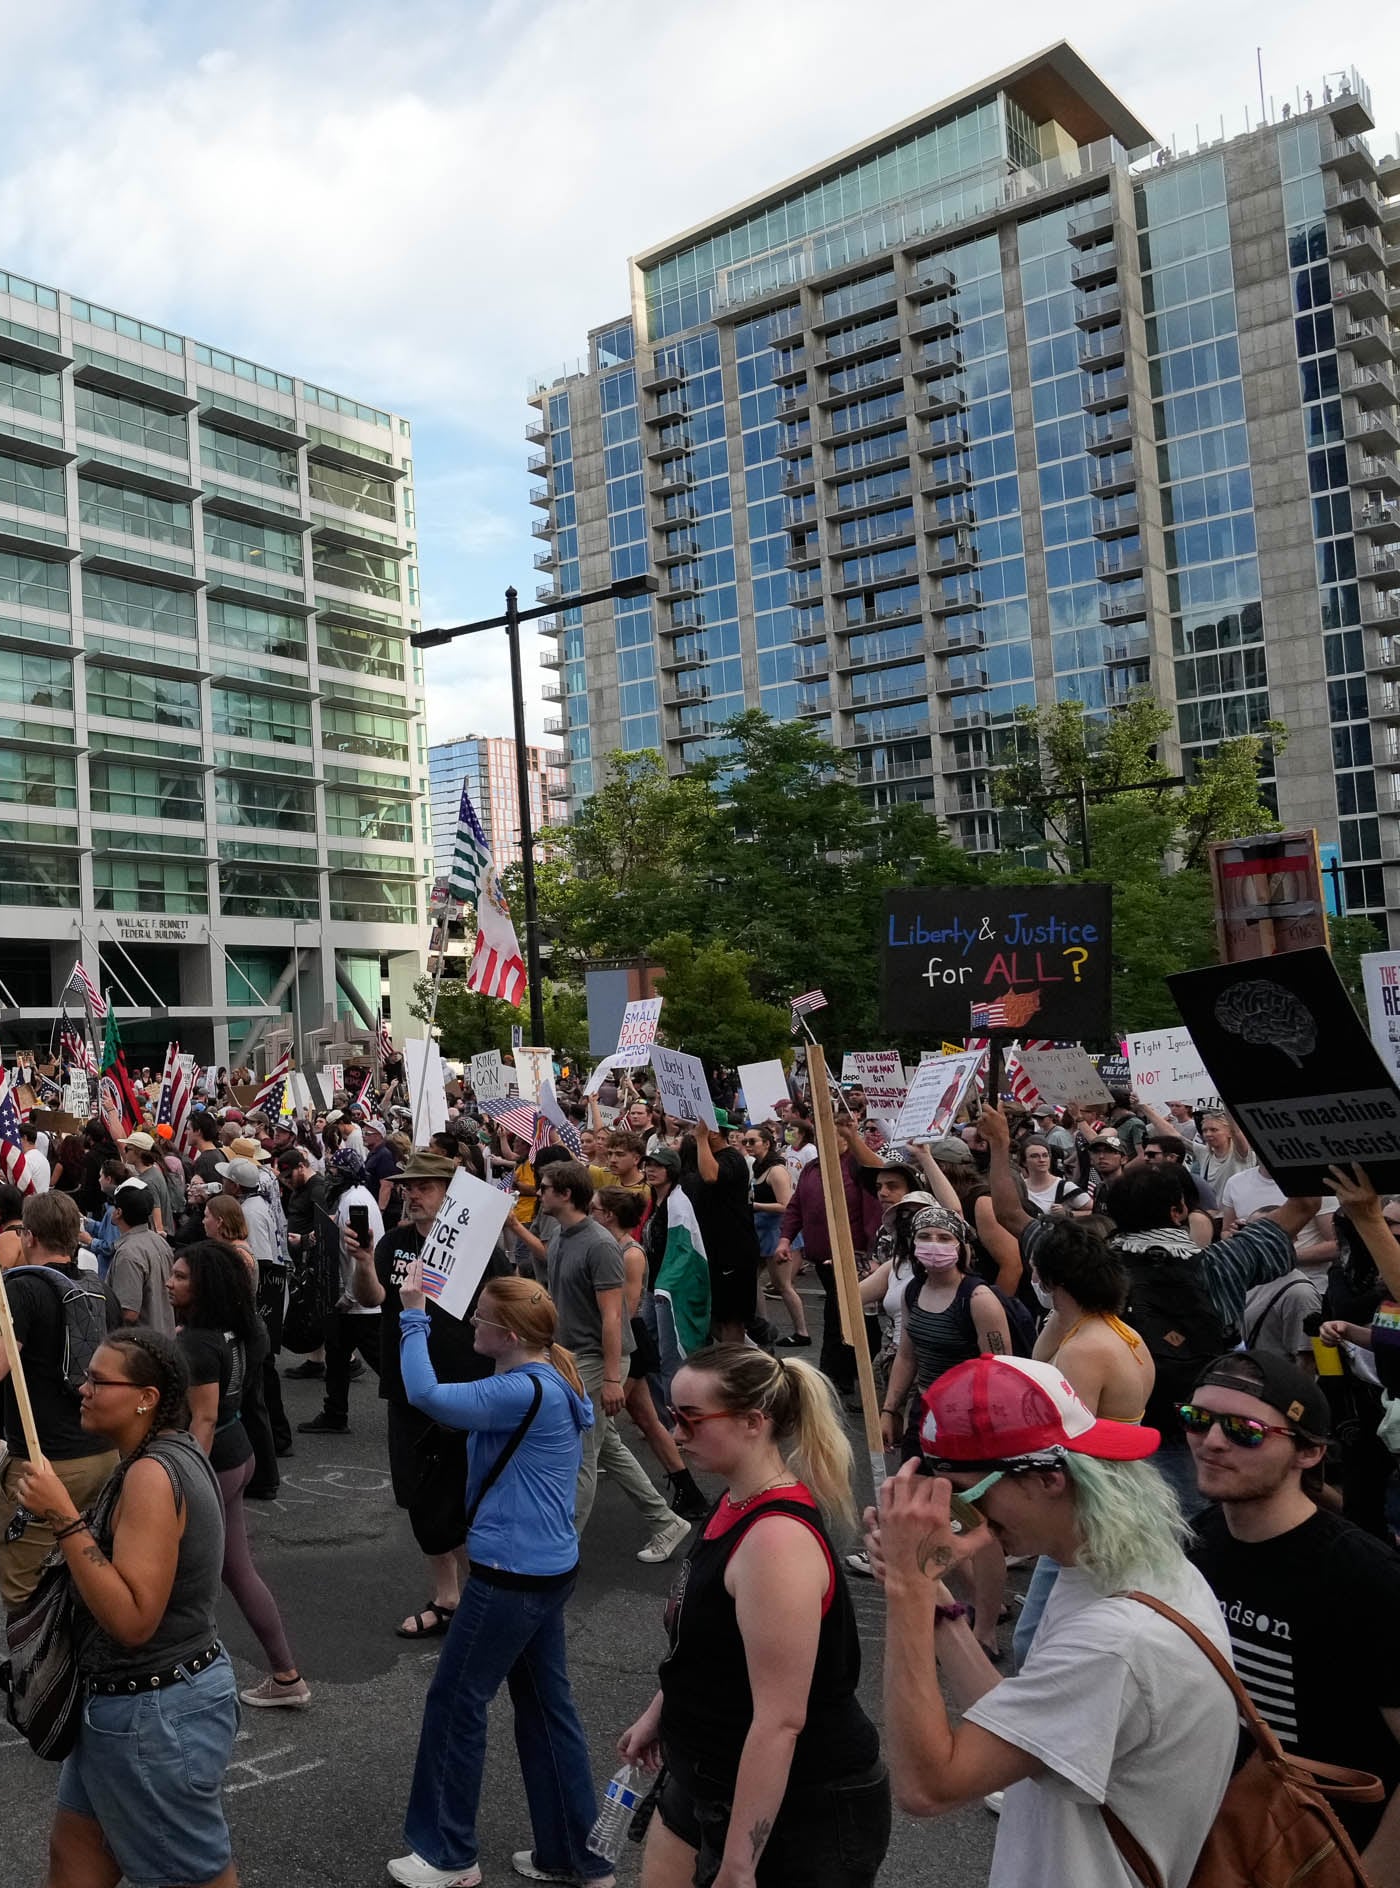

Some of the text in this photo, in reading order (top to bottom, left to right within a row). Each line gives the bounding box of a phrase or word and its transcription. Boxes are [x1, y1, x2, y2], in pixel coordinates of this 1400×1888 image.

[116, 918, 149, 928] WALLACE
[159, 919, 189, 929] BENNETT
[121, 929, 187, 940] FEDERAL BUILDING
[888, 912, 1099, 957] Liberty & Justice
[922, 957, 973, 988] for
[1379, 966, 1398, 985] THE
[624, 1010, 657, 1024] SMALL
[621, 1021, 656, 1036] DICK
[620, 1032, 654, 1046] TATOR
[1134, 1041, 1161, 1057] Fight
[475, 1053, 497, 1069] KING
[1136, 1070, 1161, 1085] NOT
[1245, 1098, 1398, 1131] This machine
[1268, 1130, 1400, 1161] kills fascist
[457, 1207, 471, 1226] &
